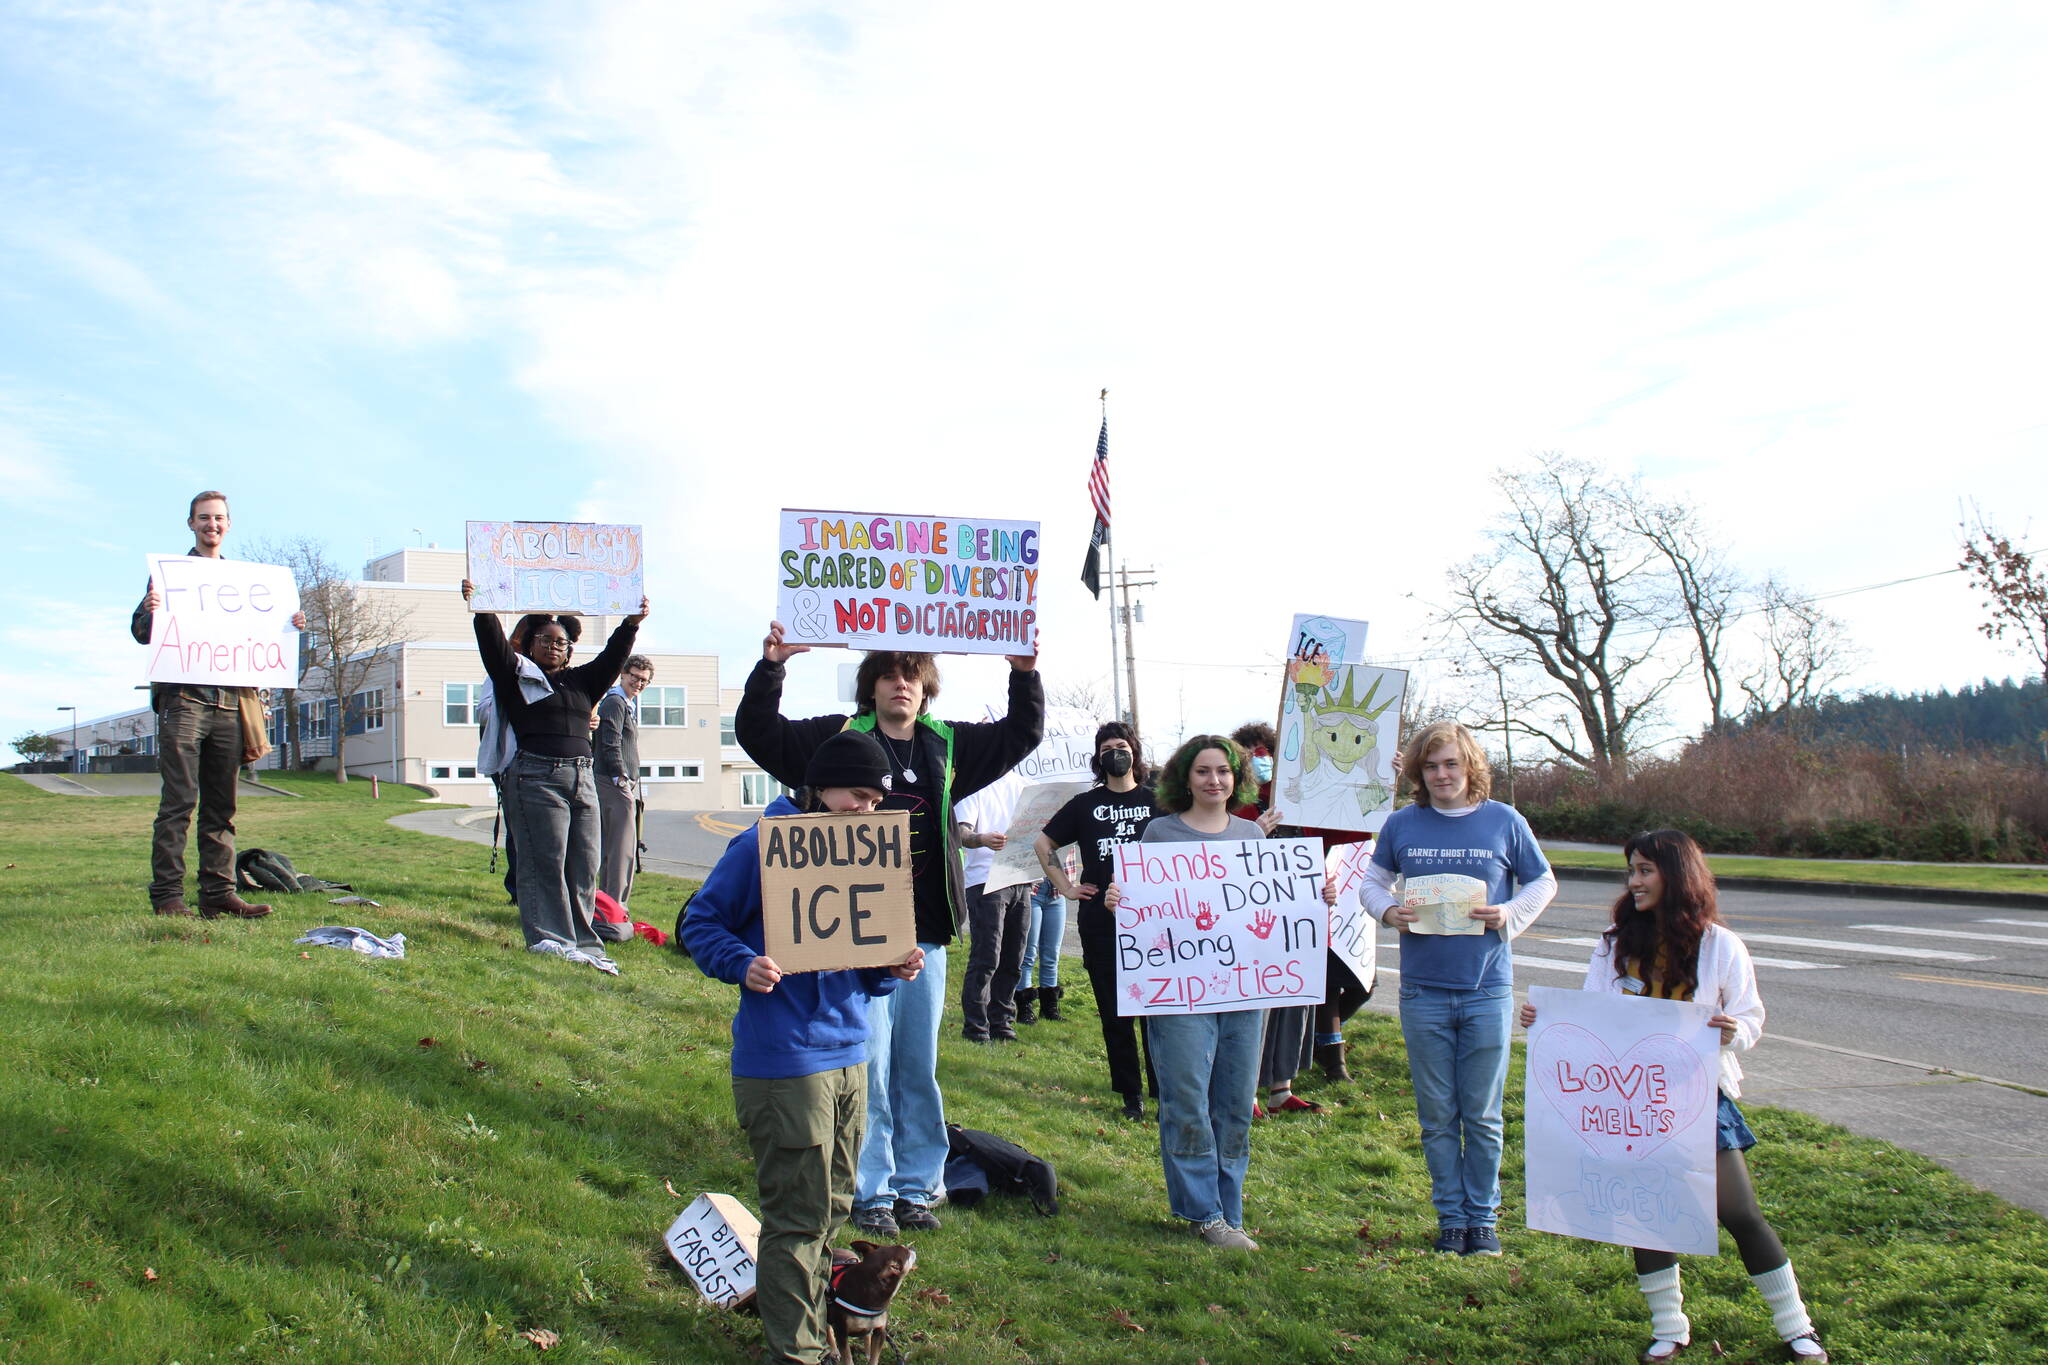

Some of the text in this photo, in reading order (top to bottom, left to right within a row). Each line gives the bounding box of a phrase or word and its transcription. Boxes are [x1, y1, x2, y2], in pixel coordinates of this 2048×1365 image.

[501, 528, 631, 569] ABOLISH
[798, 517, 1039, 564] IMAGINE BEING
[158, 560, 274, 612] Free
[527, 574, 599, 607] ICE
[781, 550, 1038, 605] SCARED OF DIVERSITY
[793, 589, 1036, 645] & NOT DICTATORSHIP
[149, 615, 287, 676] America
[1294, 632, 1323, 665] ICE
[1093, 805, 1151, 823] Chinga
[1115, 821, 1136, 836] La
[765, 824, 901, 869] ABOLISH
[1119, 841, 1227, 884] Hands
[1236, 841, 1313, 876] this
[1407, 848, 1493, 859] GARNET GHOST TOWN
[792, 884, 887, 945] ICE
[1117, 873, 1322, 929] Small DON'T
[1406, 897, 1426, 906] MELTS
[1118, 915, 1317, 971] Belong In
[1232, 960, 1304, 997] ties
[1557, 1060, 1667, 1104] LOVE
[700, 1206, 754, 1277] I BITE
